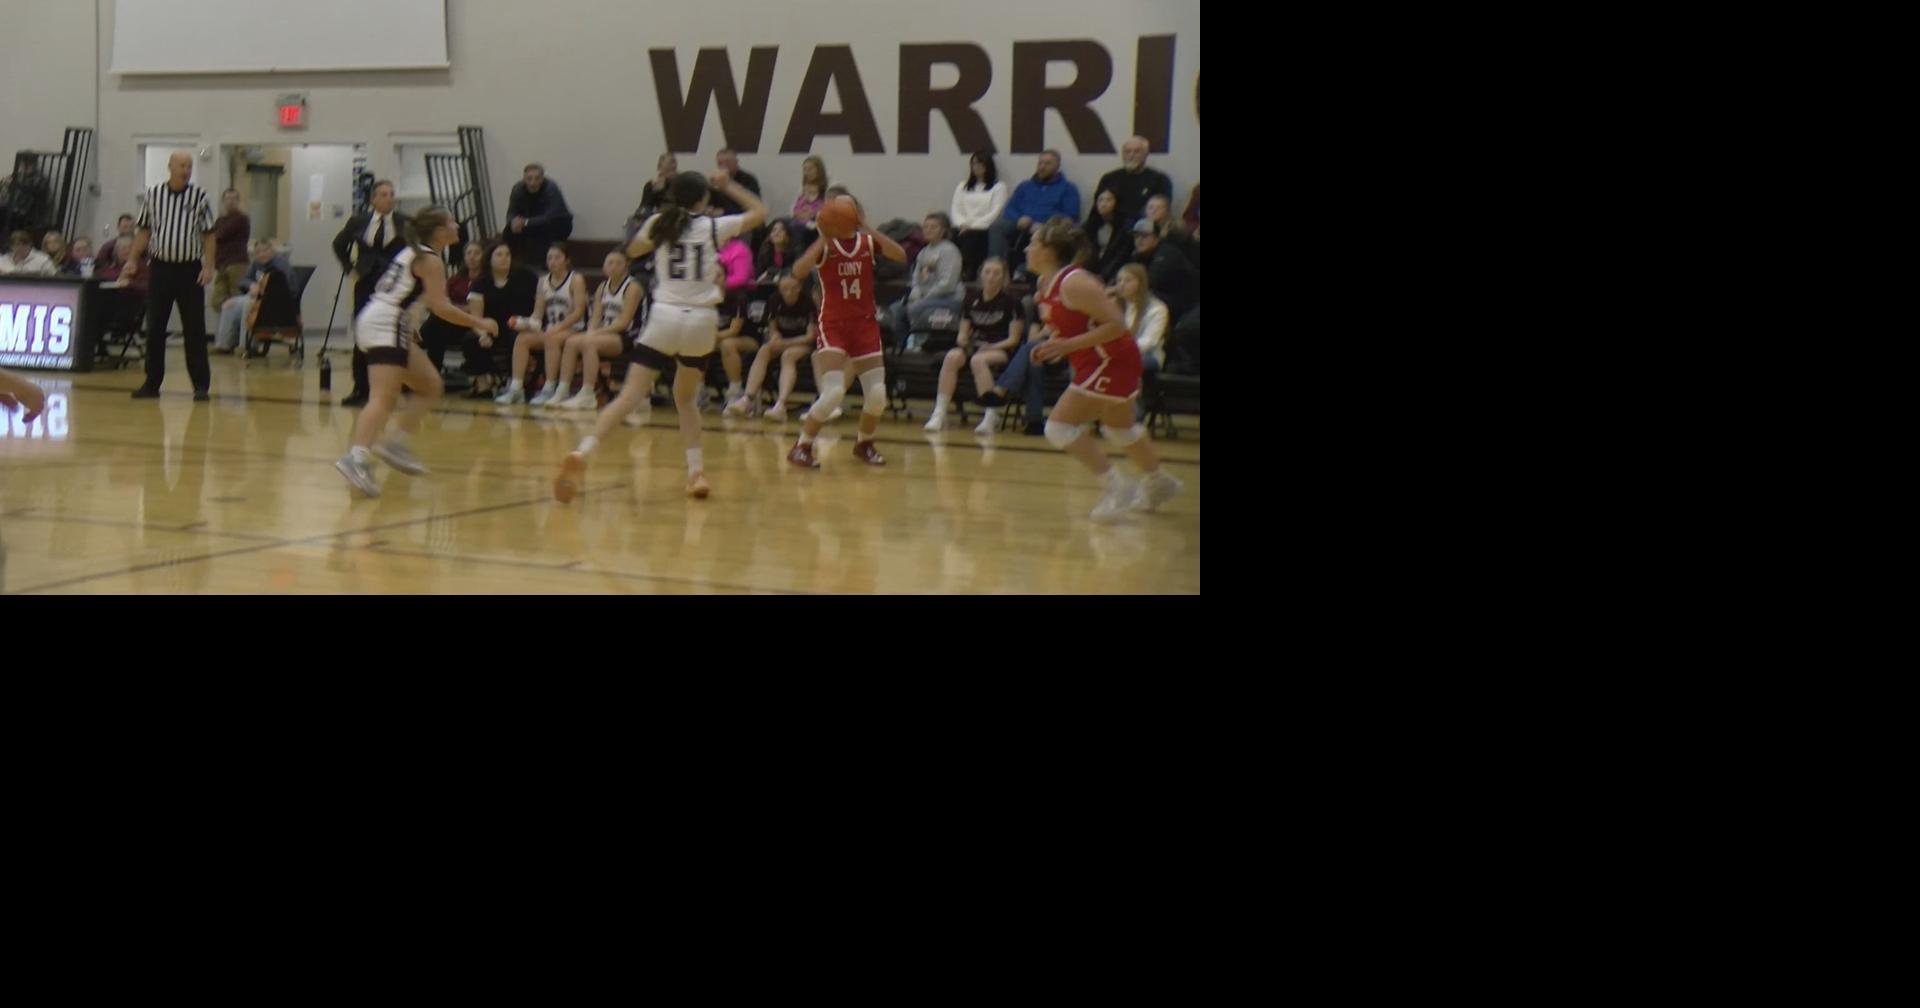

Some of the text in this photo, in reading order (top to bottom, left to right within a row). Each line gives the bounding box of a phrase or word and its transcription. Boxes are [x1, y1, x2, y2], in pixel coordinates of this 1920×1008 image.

[648, 33, 1200, 155] WARRI
[668, 244, 704, 279] 21
[838, 261, 862, 276] CONY
[841, 278, 861, 300] 14
